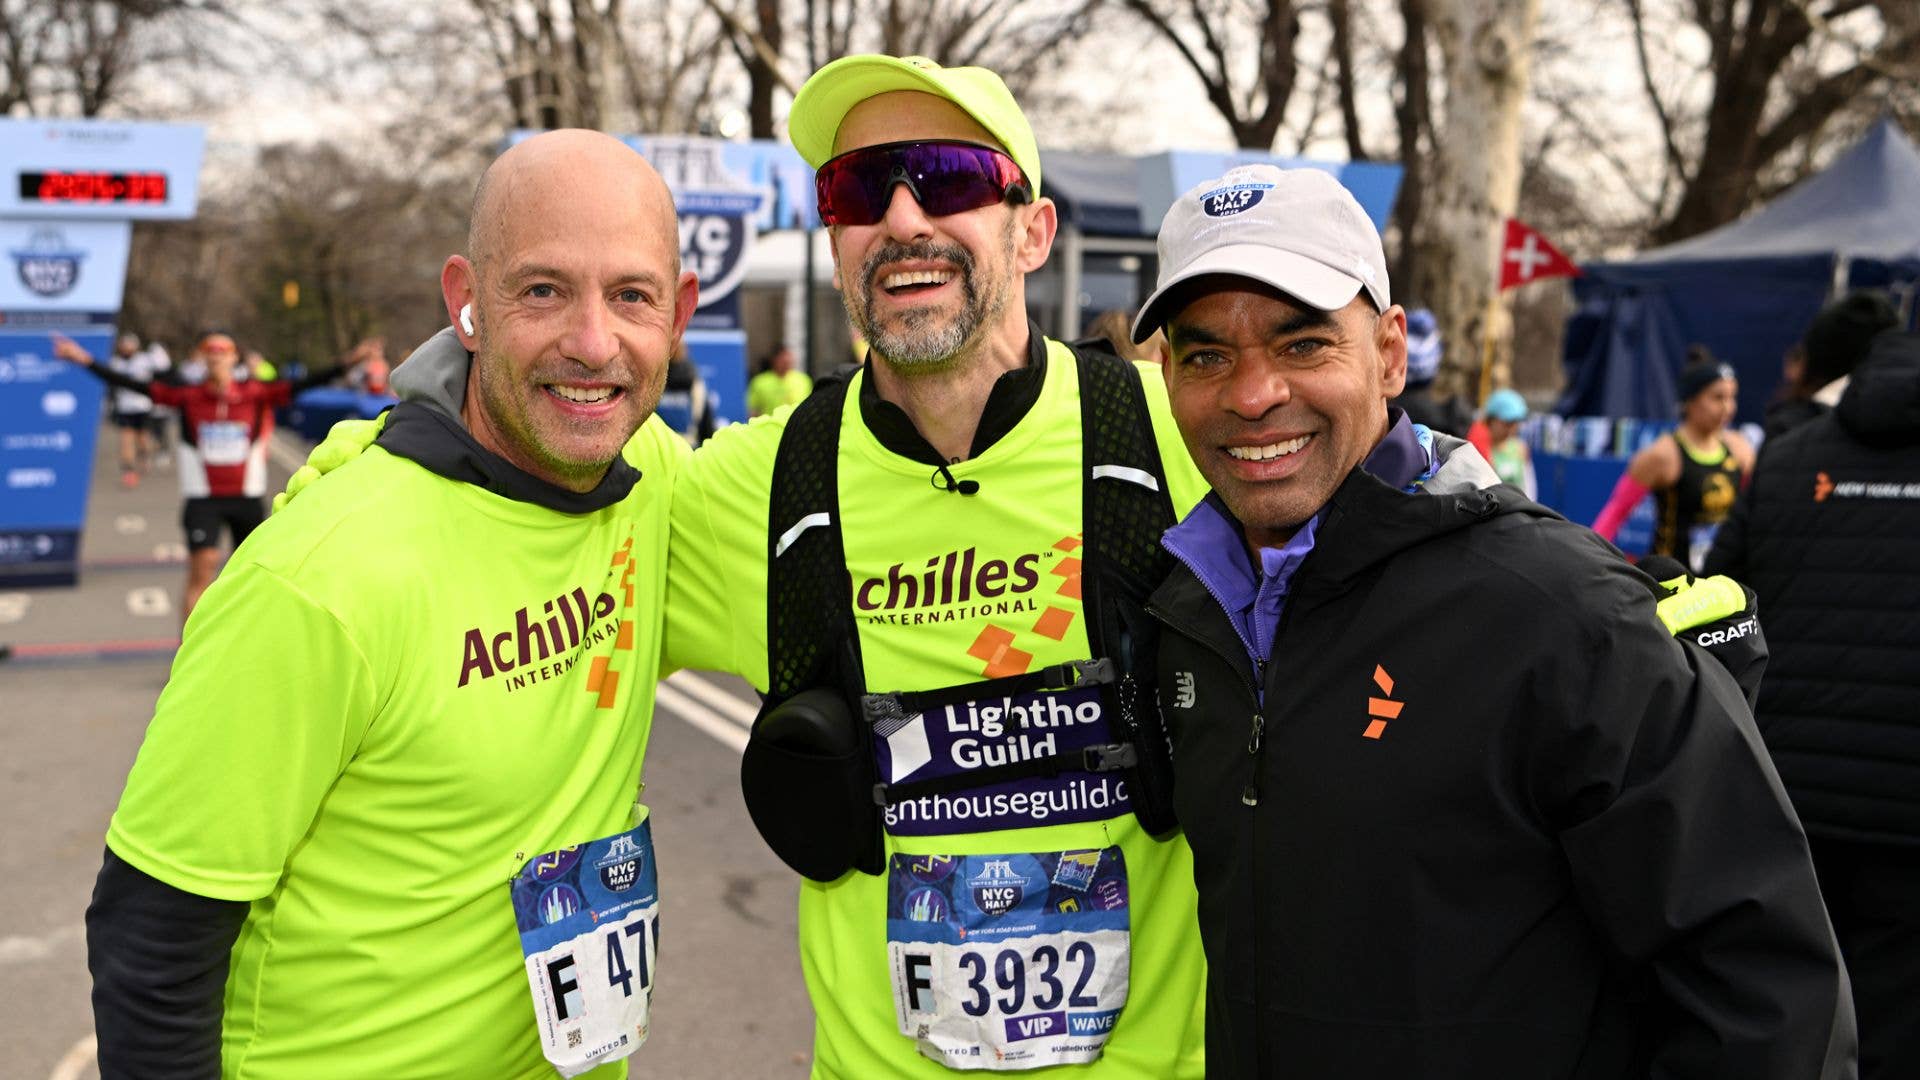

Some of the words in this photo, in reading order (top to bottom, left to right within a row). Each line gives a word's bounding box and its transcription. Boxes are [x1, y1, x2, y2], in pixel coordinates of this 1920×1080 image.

[1213, 190, 1252, 205] NYC
[1214, 199, 1249, 213] HALF
[679, 214, 731, 254] YC
[856, 546, 1040, 611] chilles
[869, 598, 1038, 625] INTERNATIONAL
[1697, 619, 1754, 647] CRAFT
[951, 733, 1057, 769] Guild
[608, 860, 636, 877] NYC
[610, 872, 635, 886] HALF
[982, 888, 1015, 900] NYC
[985, 900, 1013, 909] HALF
[547, 954, 579, 1021] F
[905, 955, 931, 1010] F
[958, 941, 1098, 1017] 3932
[1018, 1017, 1053, 1037] VIP
[1073, 1015, 1113, 1031] WAVE
[585, 1041, 619, 1059] UNITED
